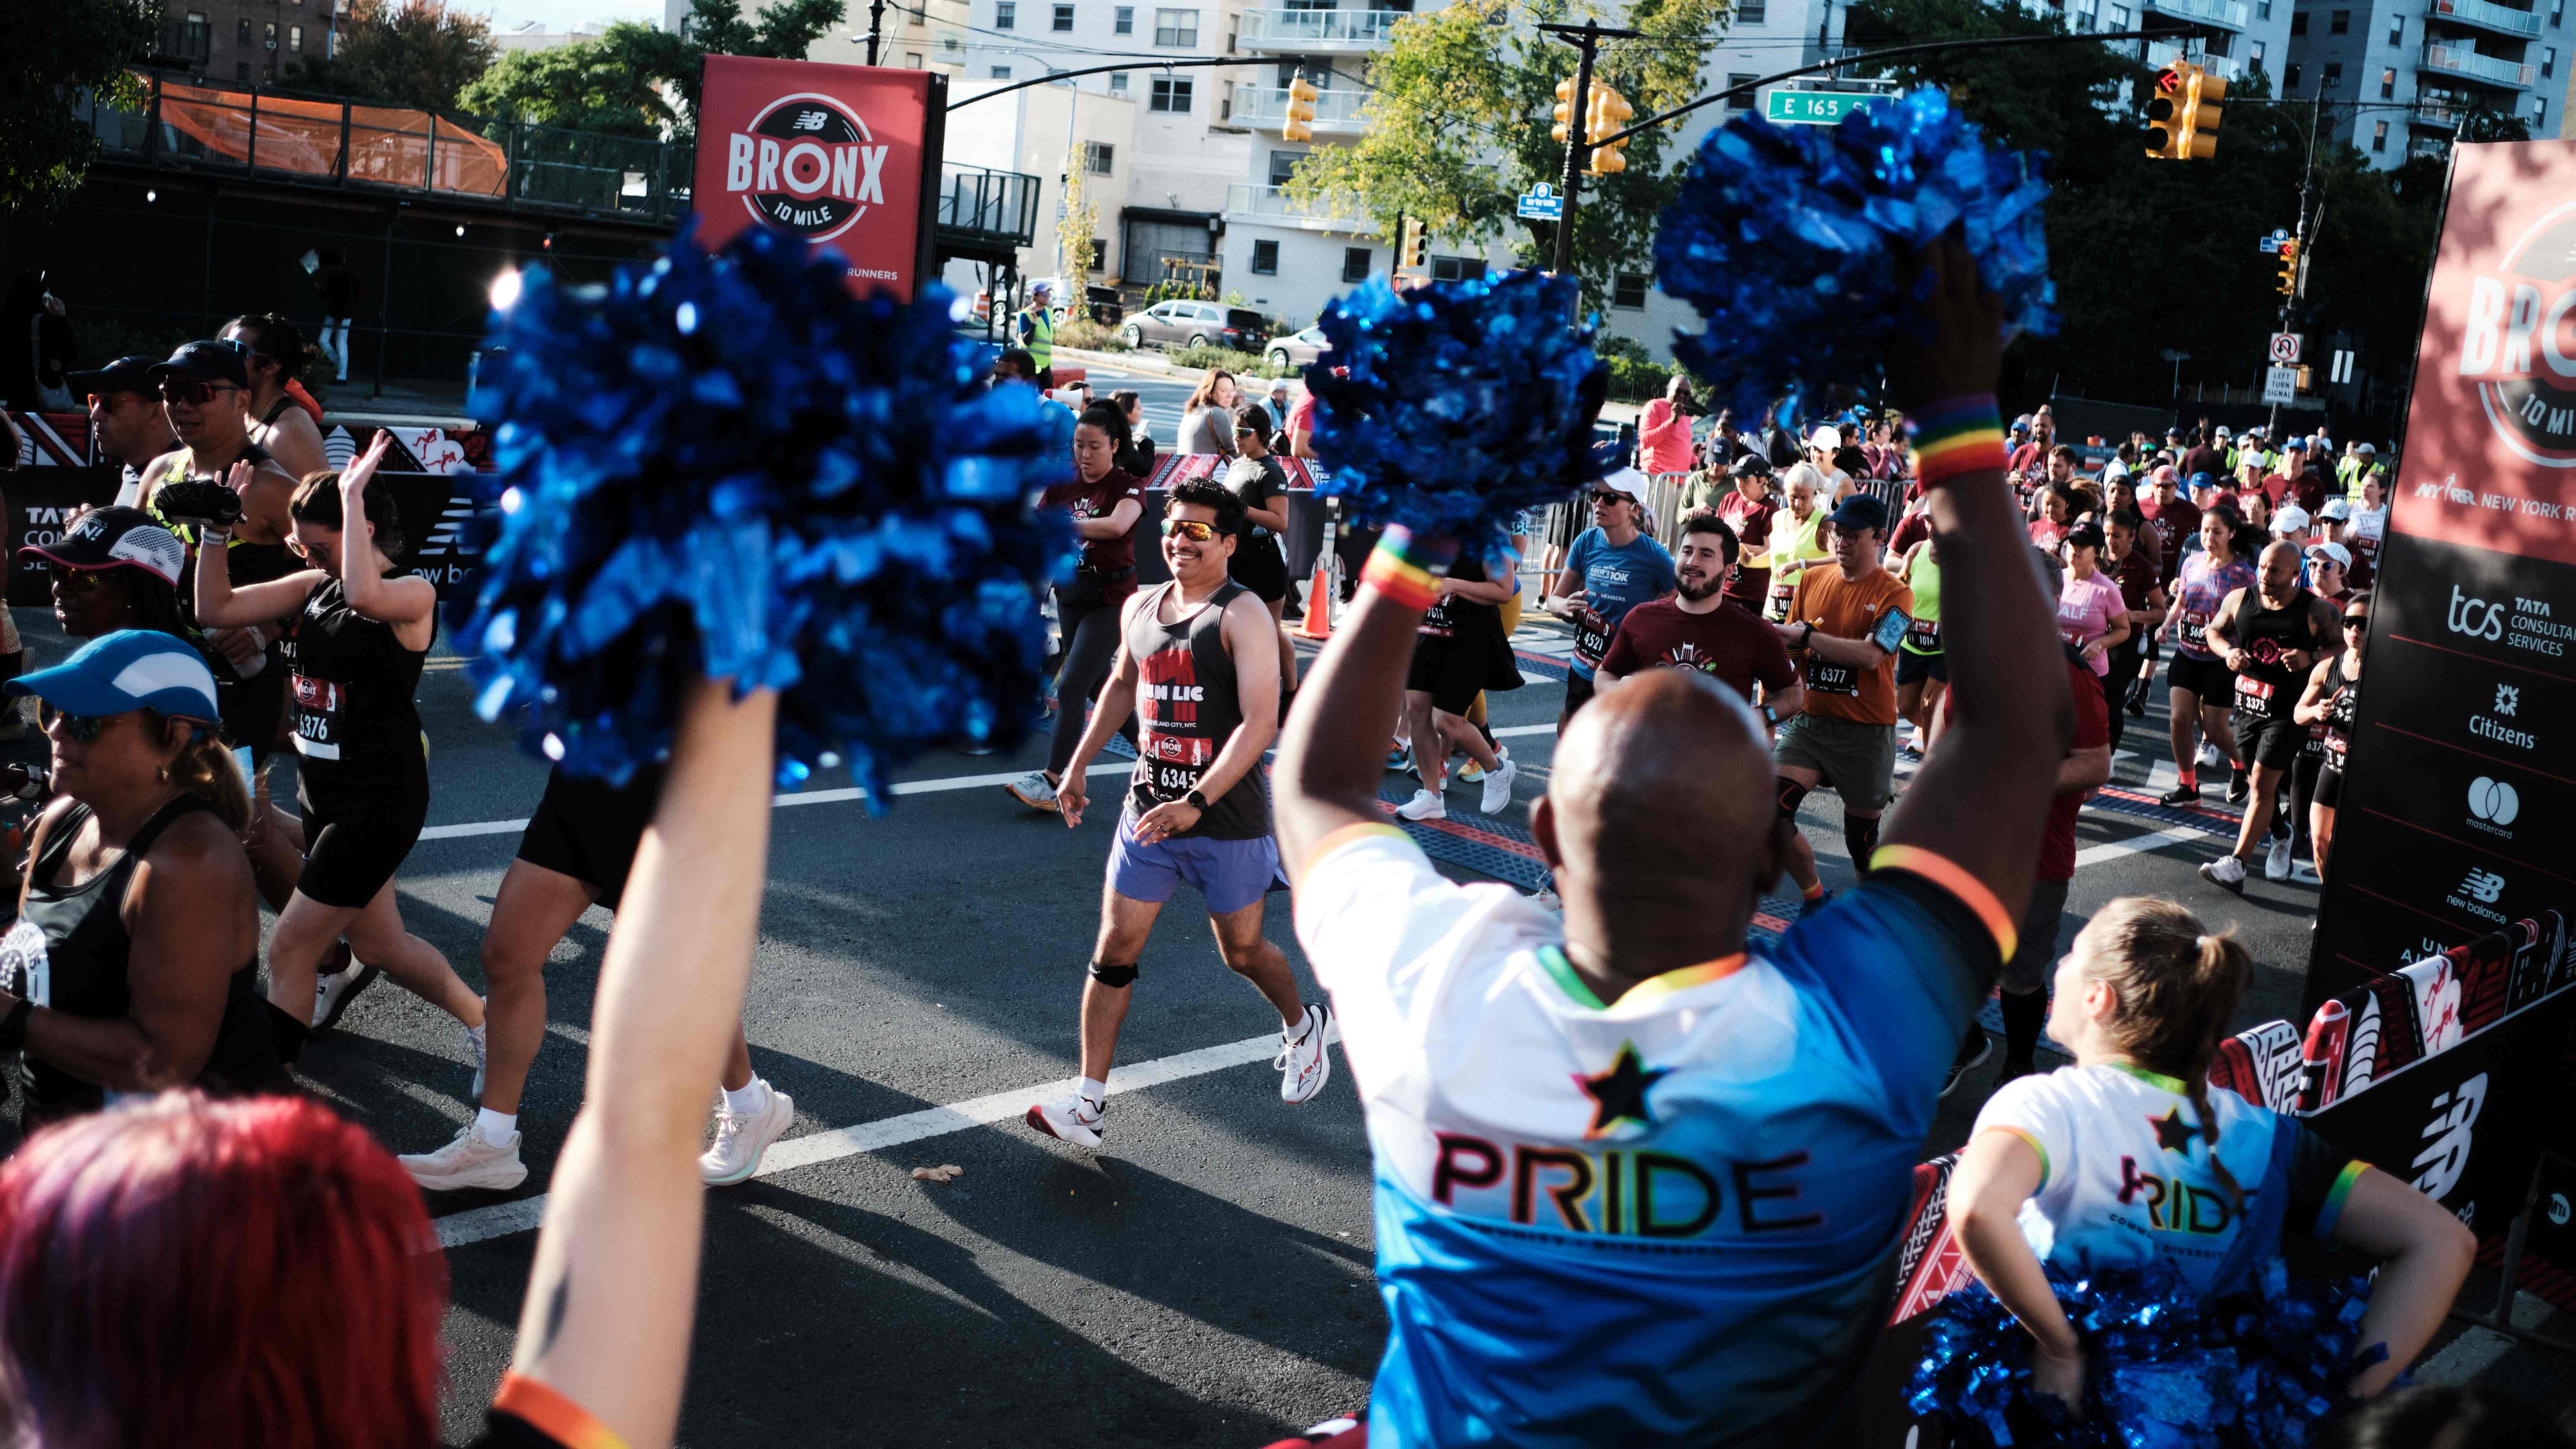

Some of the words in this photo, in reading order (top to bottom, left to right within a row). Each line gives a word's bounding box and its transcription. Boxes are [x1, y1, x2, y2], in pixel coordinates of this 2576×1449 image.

[1785, 98, 1795, 114] E
[1808, 99, 1838, 116] 165
[727, 133, 889, 205] BRONX
[774, 201, 790, 222] 10
[793, 205, 833, 226] MILE
[847, 268, 898, 281] RUNNERS
[2272, 380, 2290, 389] TURN
[2273, 372, 2290, 380] LEFT
[2267, 389, 2291, 399] SIGNAL
[2520, 393, 2546, 426] 10
[2481, 493, 2516, 512] NEW
[2520, 499, 2561, 519] YORK
[1610, 571, 1629, 582] 10K
[1601, 594, 1626, 602] MEMBERS
[2448, 585, 2505, 641] tcs
[2515, 597, 2550, 617] TATA
[1584, 632, 1603, 651] 4521
[1919, 635, 1934, 646] 1016
[2507, 632, 2563, 656] SERVICES
[1821, 667, 1847, 683] 6377
[1172, 686, 1204, 701] LIC
[2246, 696, 2265, 712] 3375
[300, 713, 327, 740] 6376
[2469, 715, 2534, 749] Citizens
[1161, 741, 1182, 753] BRONX
[1161, 767, 1197, 789] 6345
[2466, 818, 2513, 839] mastercard
[2447, 895, 2467, 908] new
[2467, 900, 2507, 924] balance
[1431, 1131, 1824, 1237] PRIDE
